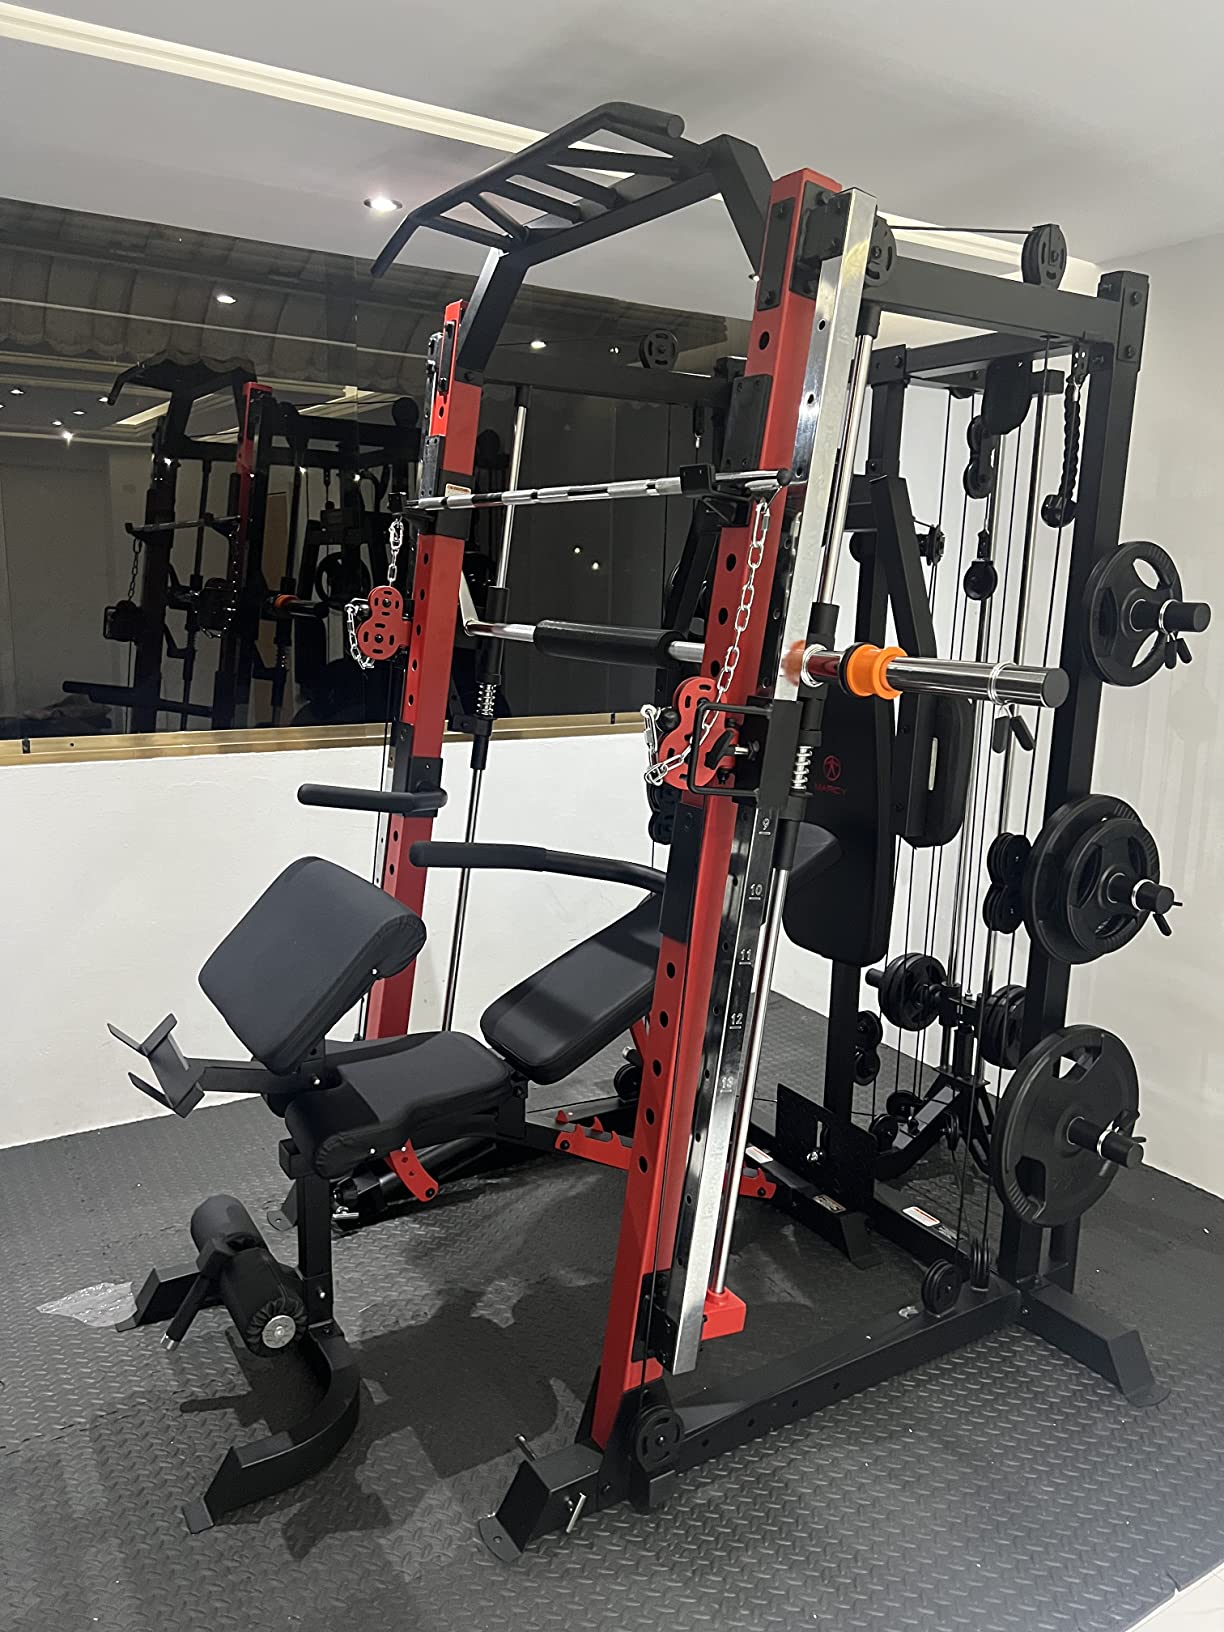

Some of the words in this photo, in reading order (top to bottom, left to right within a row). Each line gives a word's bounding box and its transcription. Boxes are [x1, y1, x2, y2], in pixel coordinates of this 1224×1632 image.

[762, 818, 770, 830] 9
[750, 884, 763, 896] 10
[740, 949, 752, 960] 11
[731, 1013, 743, 1025] 12
